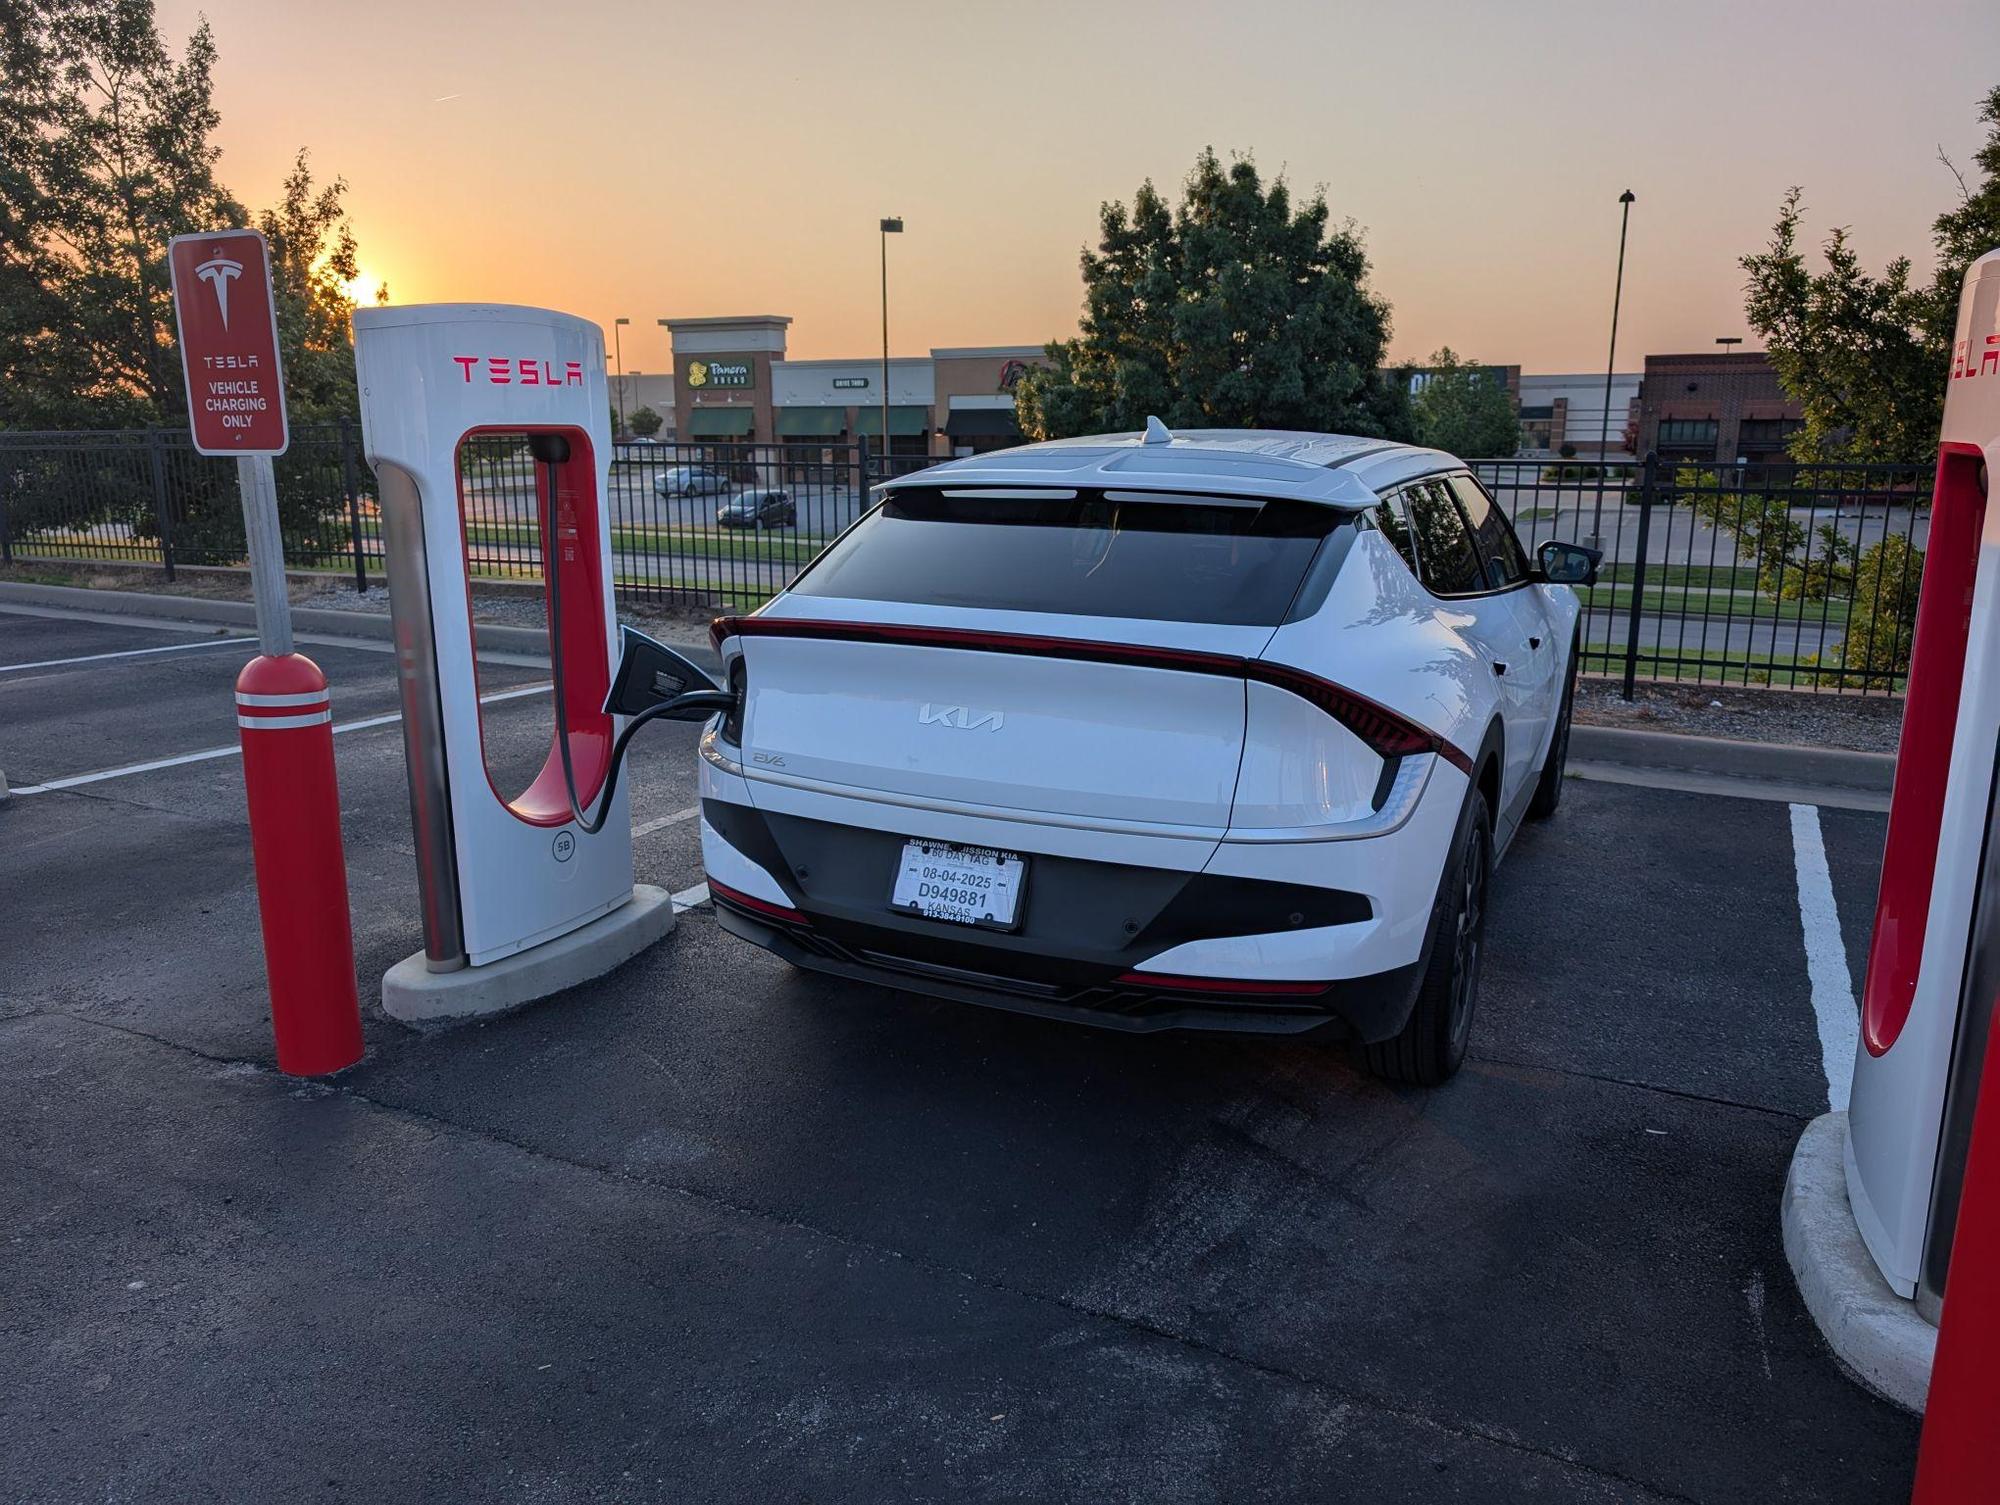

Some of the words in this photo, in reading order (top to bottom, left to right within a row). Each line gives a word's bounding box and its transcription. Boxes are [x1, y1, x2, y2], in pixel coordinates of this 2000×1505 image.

[204, 355, 258, 369] TESLA
[1949, 334, 2000, 380] SLA
[453, 357, 582, 386] TESLA
[710, 362, 747, 375] Panera
[208, 380, 259, 395] VEHICLE
[205, 397, 267, 412] CHARGING
[222, 414, 253, 428] ONLY
[919, 703, 1005, 733] KIA
[752, 751, 787, 767] EV6
[557, 840, 570, 853] 5B
[909, 838, 953, 851] SHAWNE
[1000, 851, 1018, 861] KIA
[945, 851, 967, 861] DAY
[968, 854, 990, 866] TAG
[922, 866, 992, 889] 08-04-2025
[918, 882, 987, 908] D949881
[927, 901, 971, 917] KANSAS
